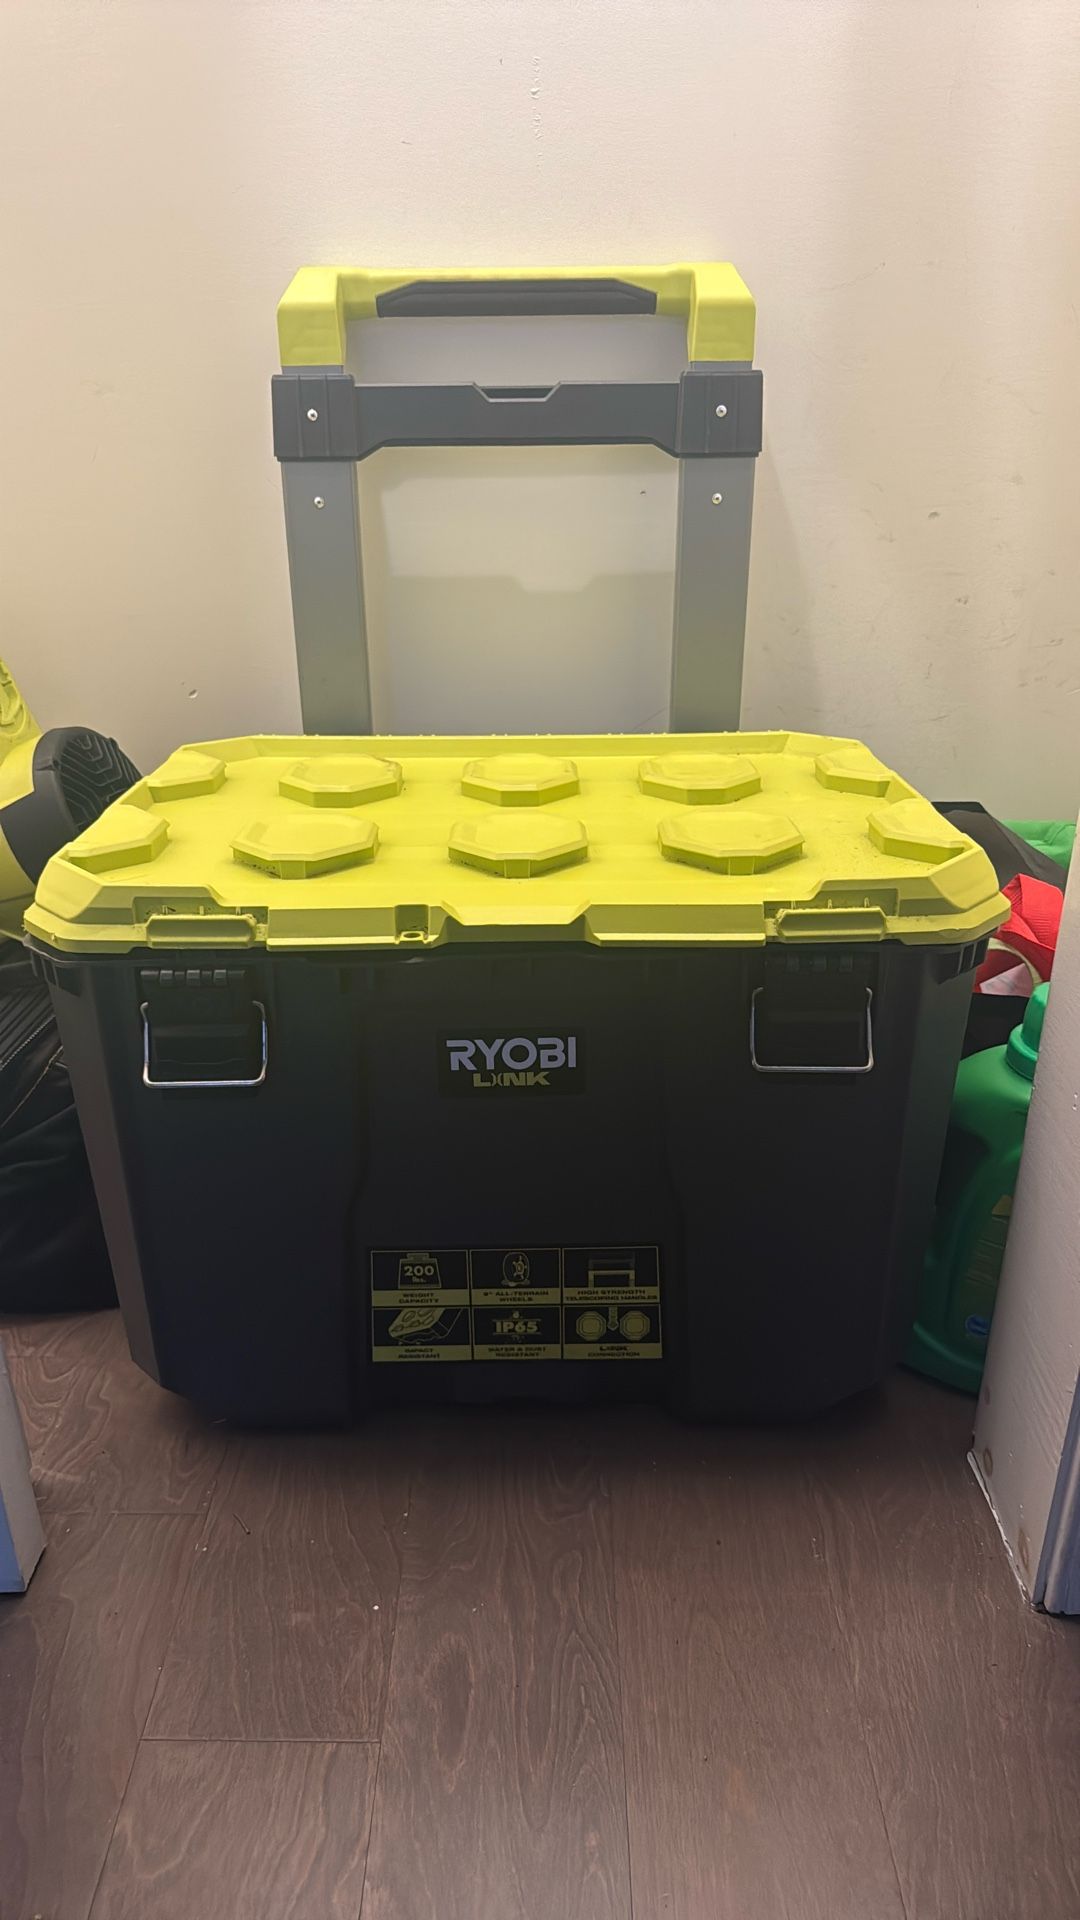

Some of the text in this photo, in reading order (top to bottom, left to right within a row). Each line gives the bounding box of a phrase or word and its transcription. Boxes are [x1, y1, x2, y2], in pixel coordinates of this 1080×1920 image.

[446, 1036, 577, 1071] RYOBI
[472, 1071, 551, 1088] LINK
[404, 1265, 435, 1277] 200
[495, 1321, 538, 1334] IP65
